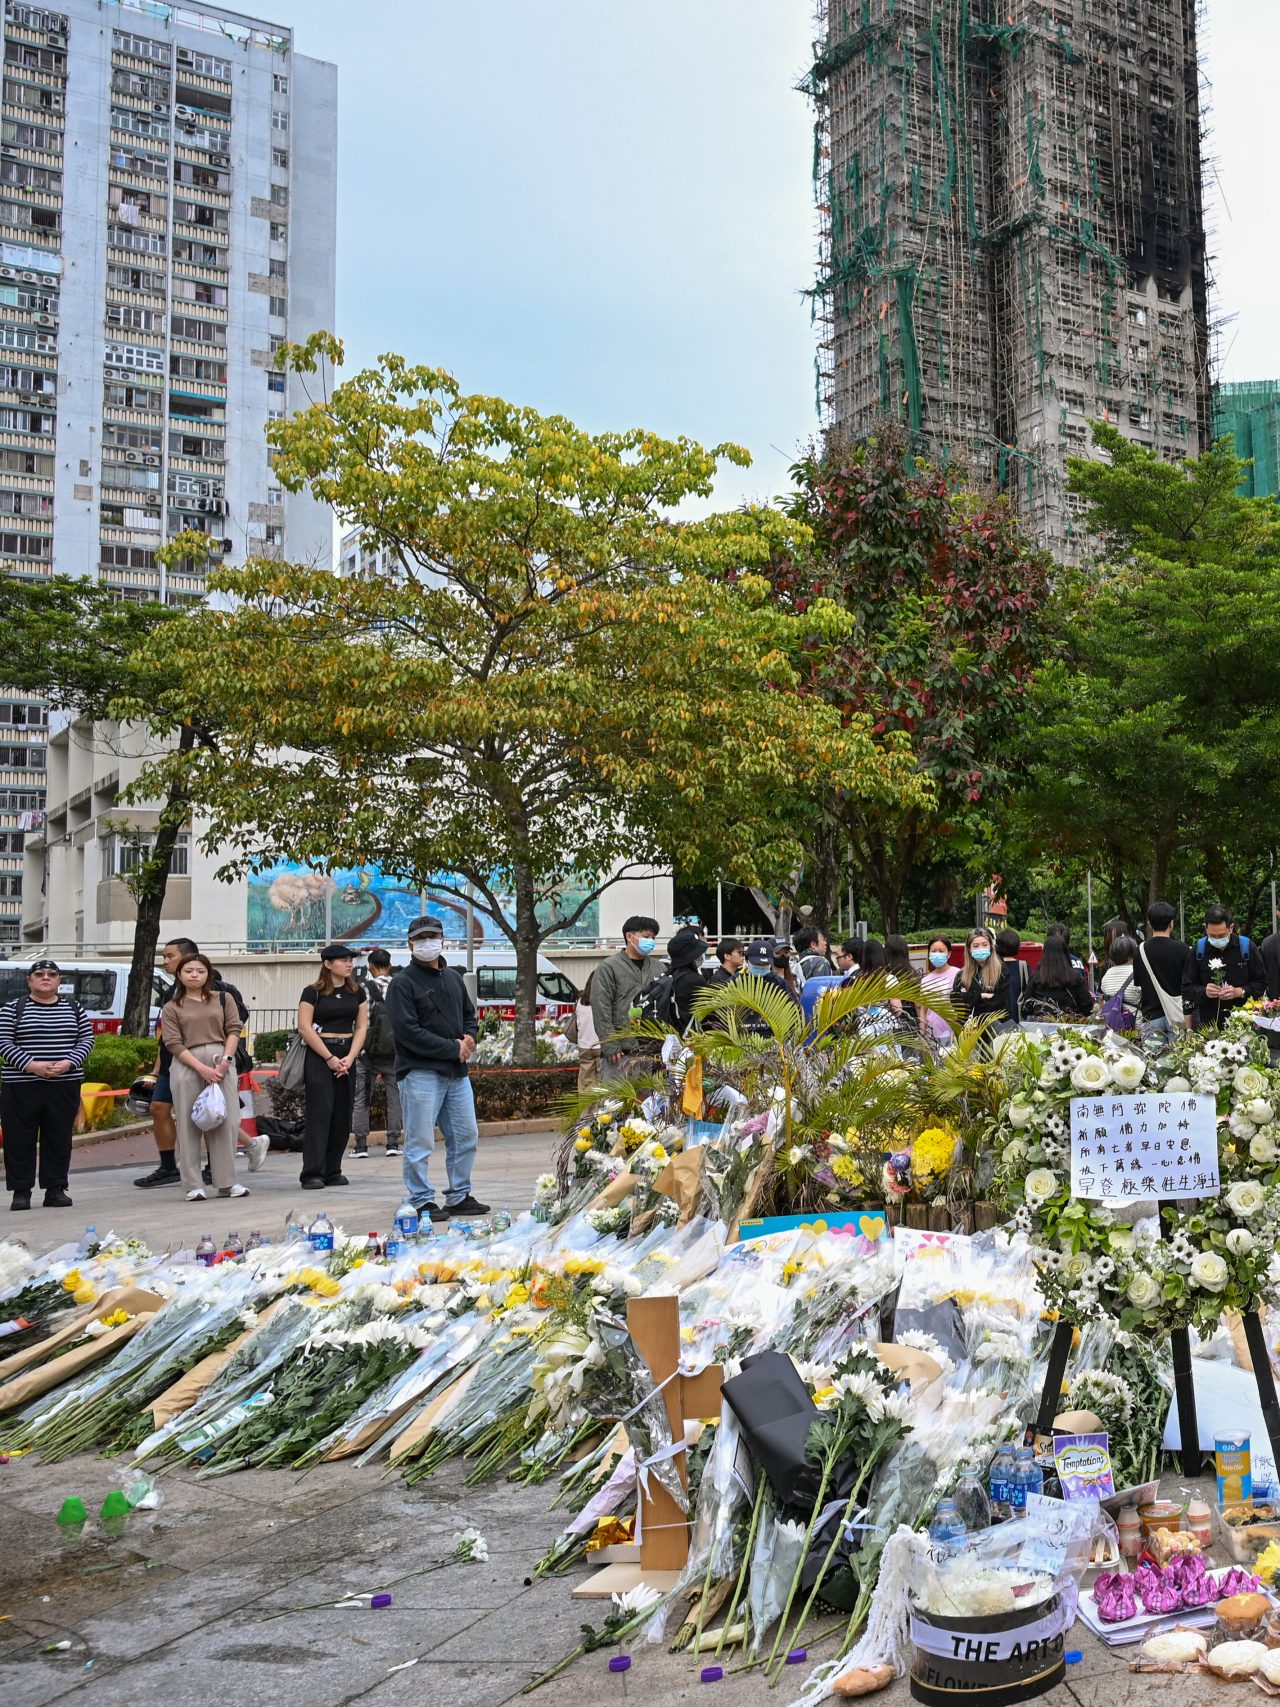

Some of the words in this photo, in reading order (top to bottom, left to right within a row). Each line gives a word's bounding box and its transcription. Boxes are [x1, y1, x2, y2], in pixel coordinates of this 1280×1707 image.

[1060, 1455, 1104, 1471] Temptations
[951, 1635, 1001, 1663] THE
[1008, 1637, 1051, 1663] ART
